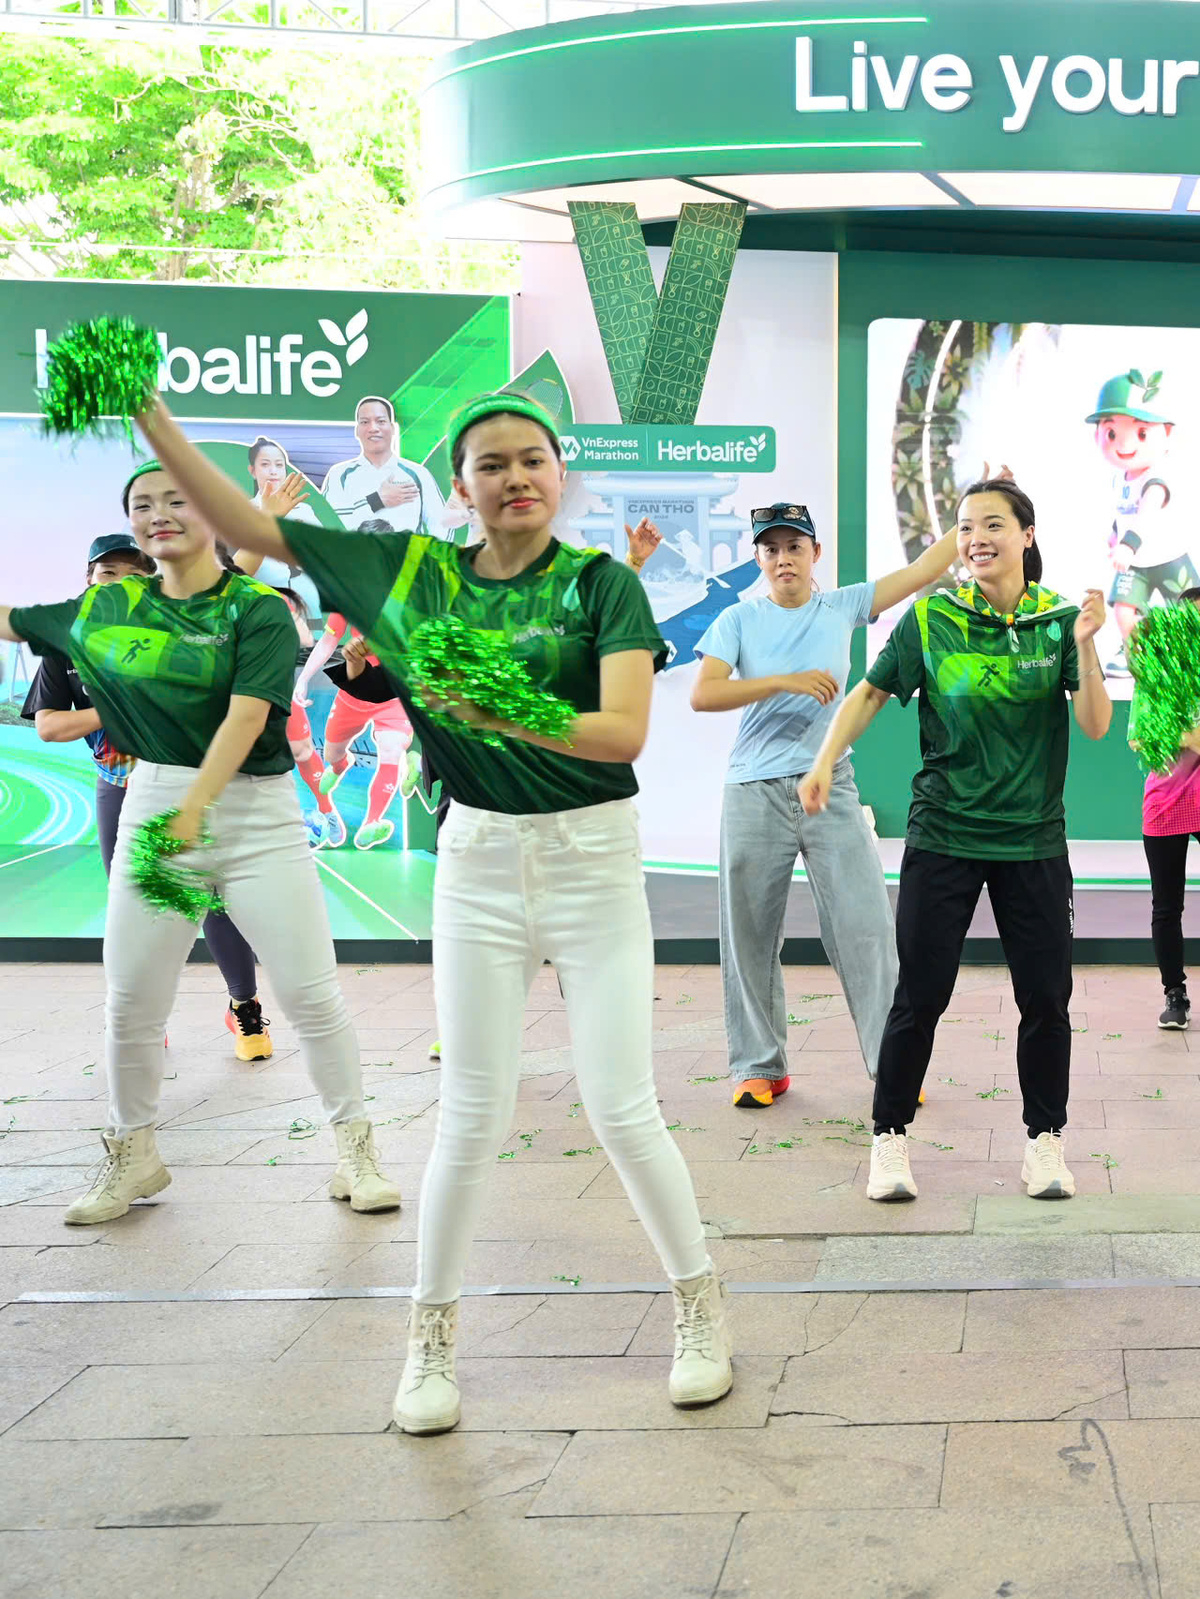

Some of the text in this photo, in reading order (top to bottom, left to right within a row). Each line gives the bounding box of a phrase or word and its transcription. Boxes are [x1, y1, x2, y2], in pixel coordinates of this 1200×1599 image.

[795, 36, 973, 113] Live
[998, 54, 1200, 133] your
[35, 327, 343, 397] balife
[581, 437, 639, 450] VnExpress
[584, 449, 639, 460] Marathon
[657, 439, 758, 463] Herbalife
[627, 504, 695, 514] CAN THO
[1017, 656, 1054, 669] Herbalife
